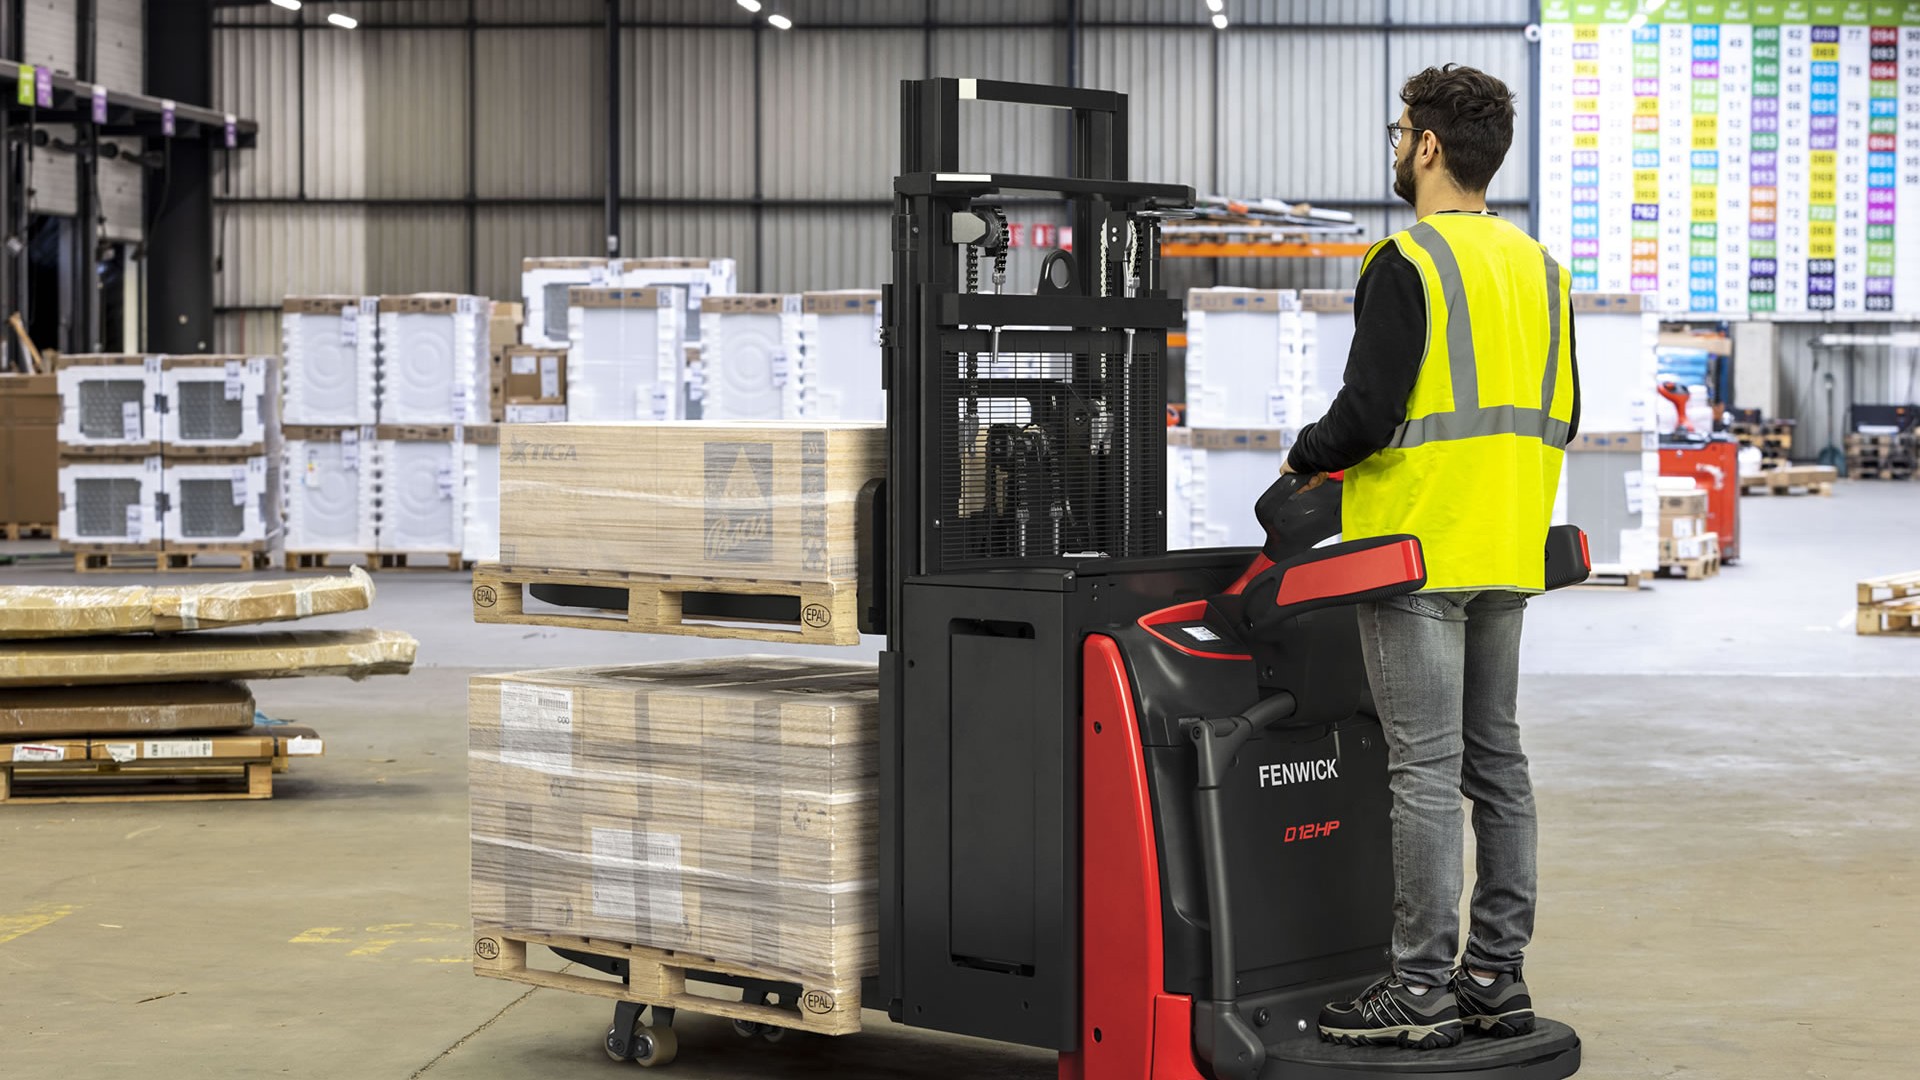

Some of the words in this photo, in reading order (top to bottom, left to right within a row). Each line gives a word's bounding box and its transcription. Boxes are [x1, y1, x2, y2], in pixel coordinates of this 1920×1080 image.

[477, 590, 494, 602] EPAL
[806, 608, 827, 622] EPAL
[1258, 758, 1339, 788] FENWICK
[479, 942, 497, 955] EPAL
[808, 994, 830, 1008] EPAL
